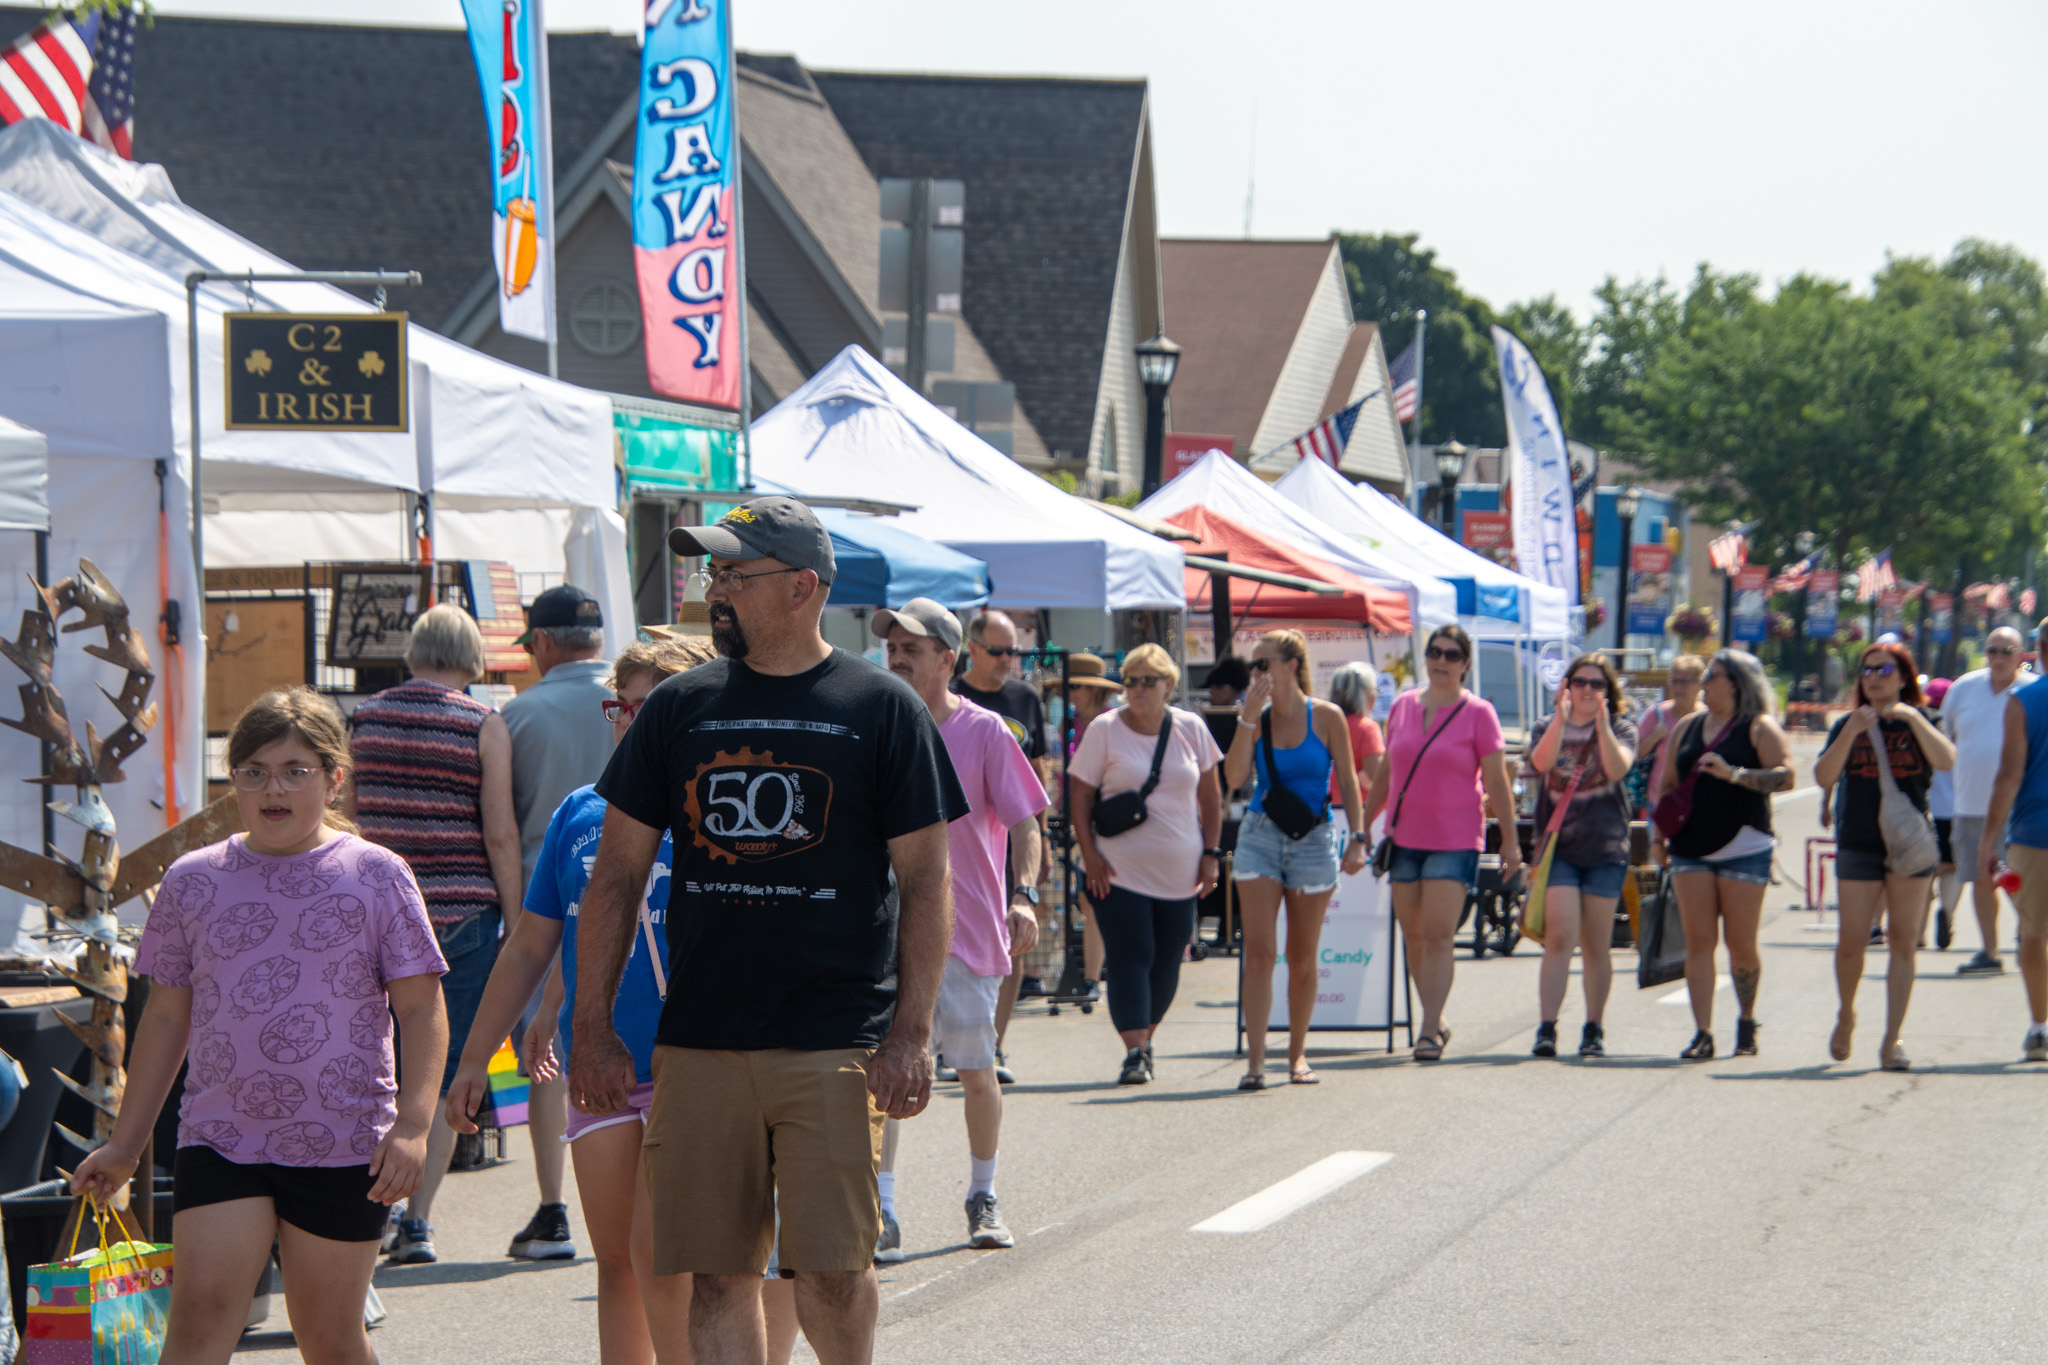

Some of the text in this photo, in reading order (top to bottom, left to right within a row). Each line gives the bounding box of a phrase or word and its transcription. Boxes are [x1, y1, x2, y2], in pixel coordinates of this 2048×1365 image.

[287, 323, 342, 352] C2
[299, 358, 331, 386] &
[257, 392, 374, 421] IRISH
[718, 719, 765, 729] INTERNATIONAL
[767, 719, 807, 730] ENGINEERING
[704, 771, 794, 838] 50
[794, 794, 805, 814] 1968
[1320, 948, 1373, 967] Candy
